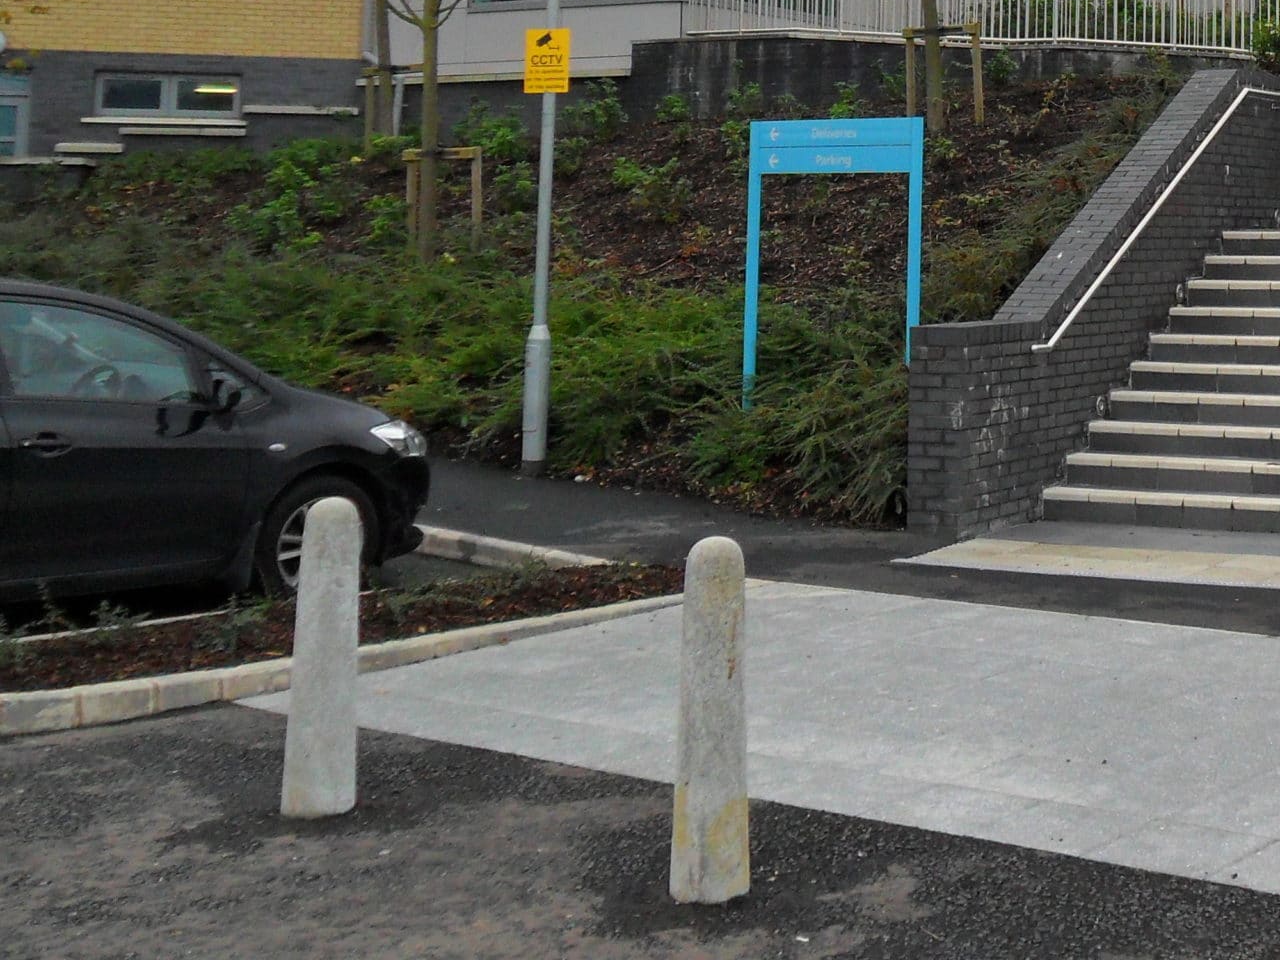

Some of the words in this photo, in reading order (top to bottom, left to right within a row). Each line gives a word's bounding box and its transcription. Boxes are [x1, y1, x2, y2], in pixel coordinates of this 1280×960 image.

[531, 54, 562, 65] CCTV
[811, 127, 857, 139] Deliveries
[815, 153, 852, 167] Parking
